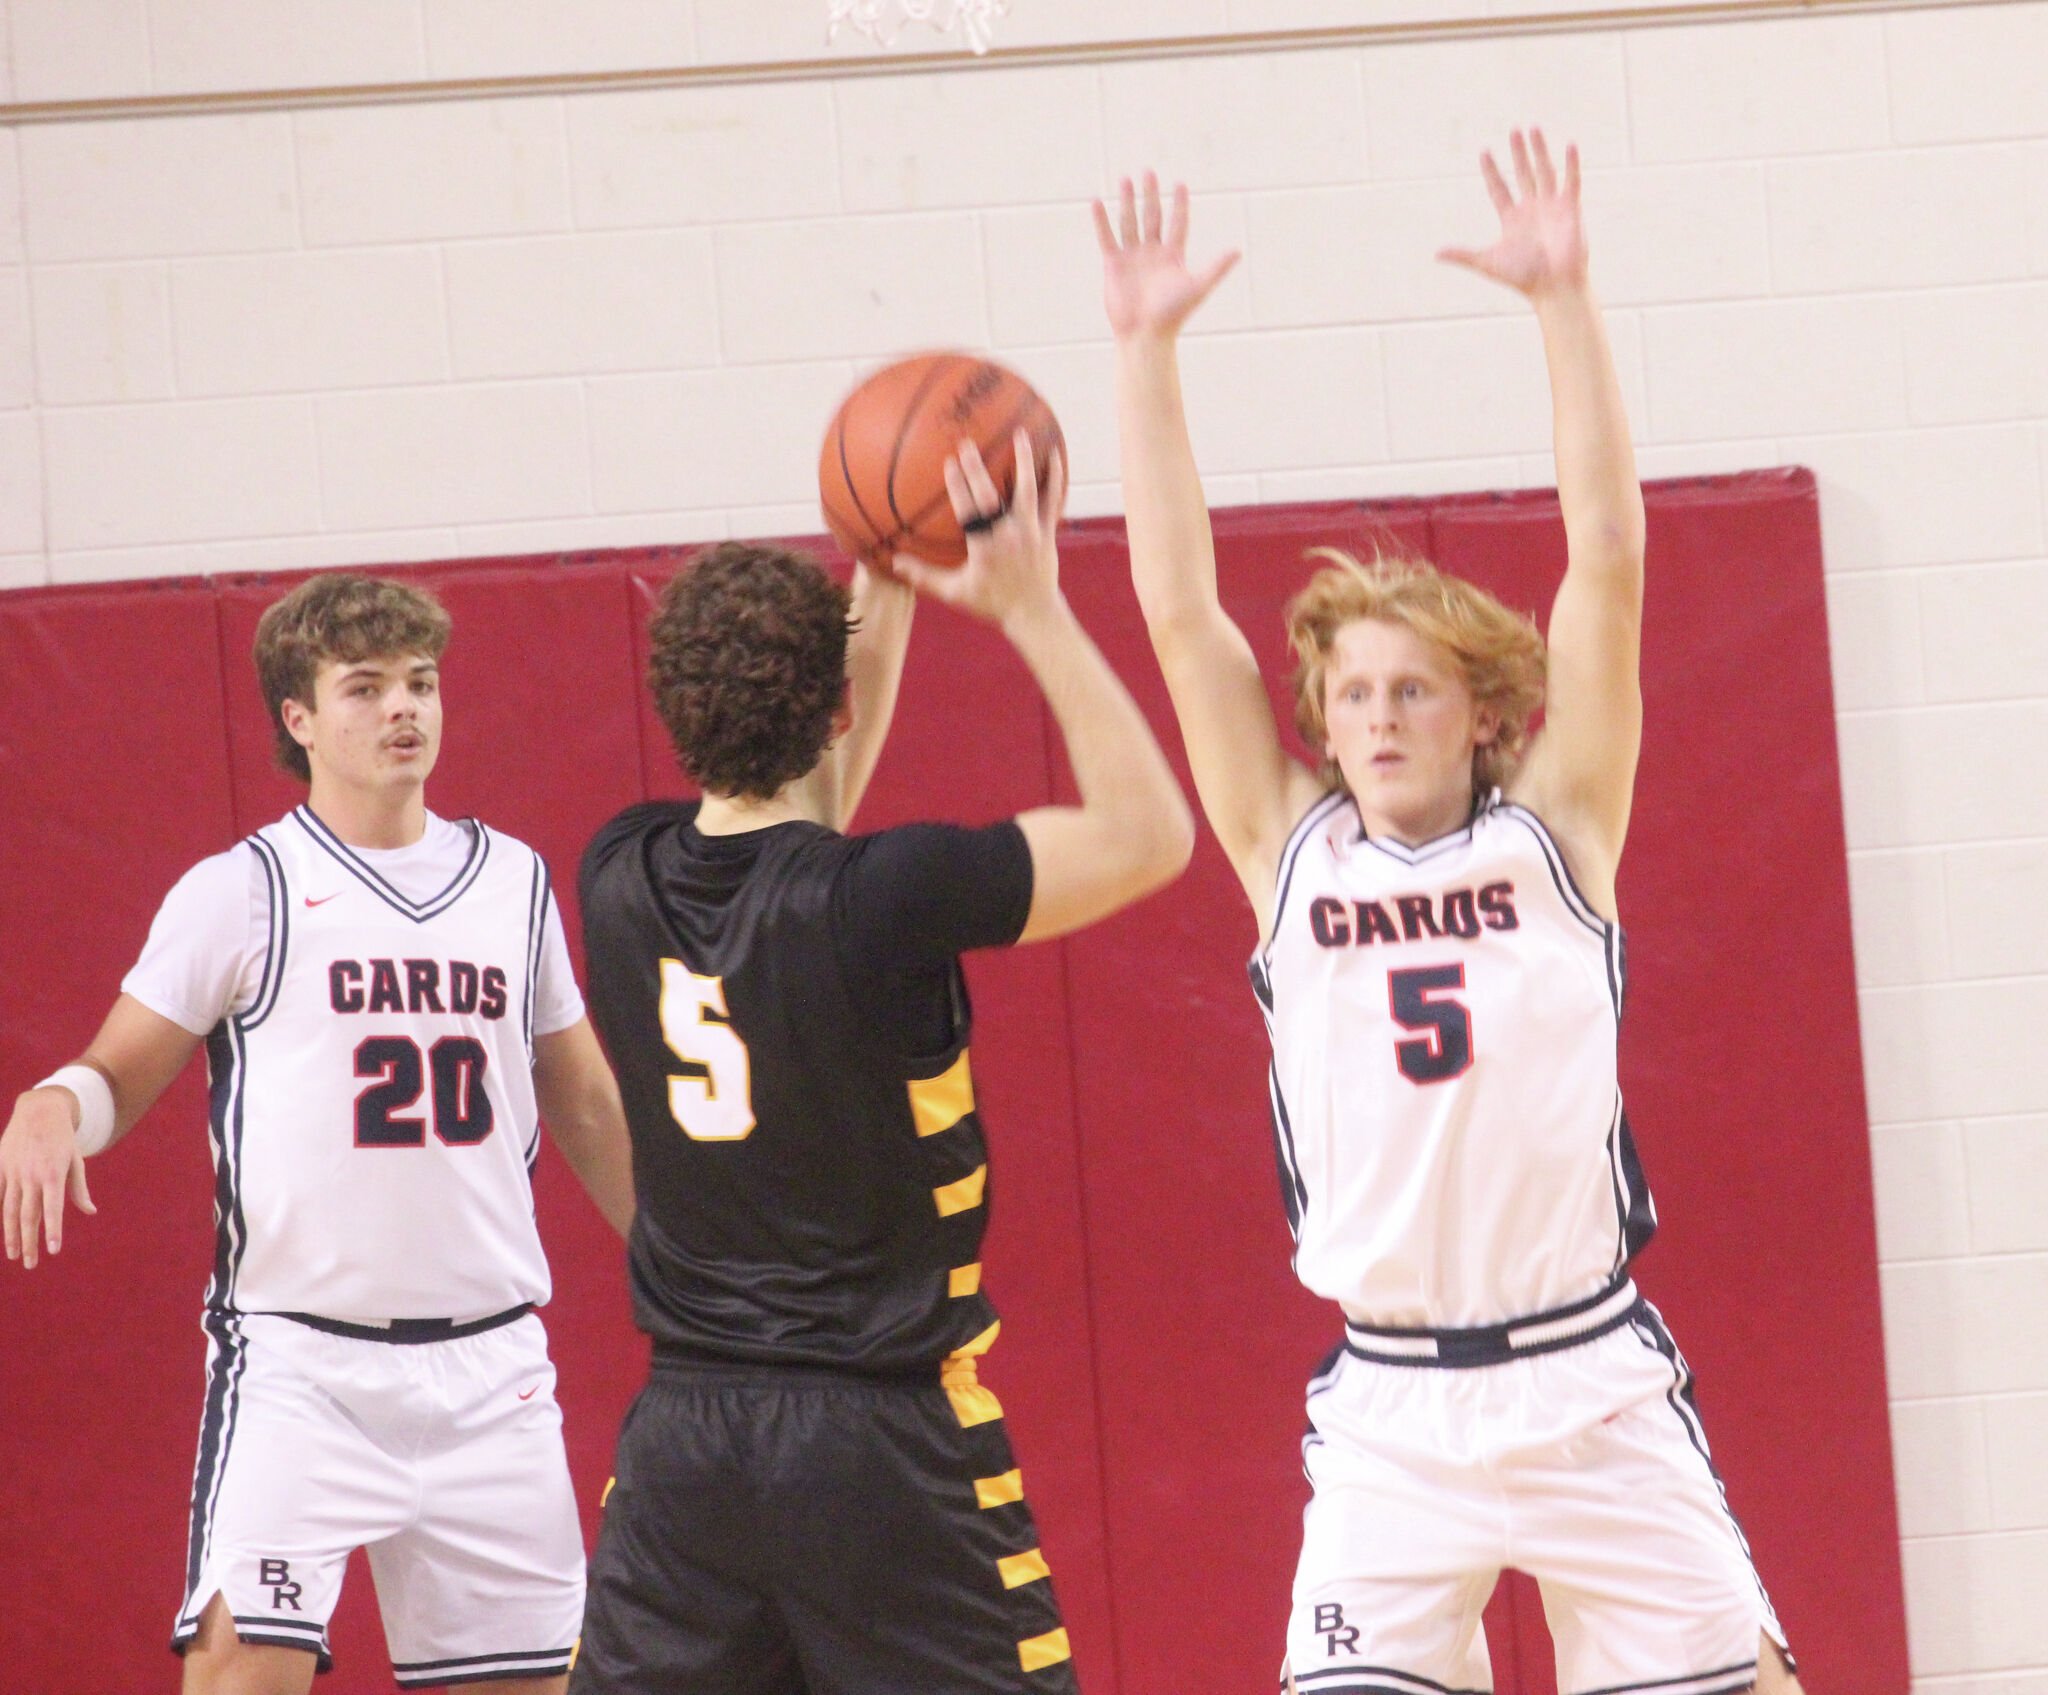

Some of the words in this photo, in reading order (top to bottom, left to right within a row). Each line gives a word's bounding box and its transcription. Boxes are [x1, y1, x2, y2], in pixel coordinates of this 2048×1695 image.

[1309, 880, 1519, 947] CARDS
[329, 958, 507, 1020] CARDS
[1387, 961, 1474, 1086] 5
[353, 1035, 494, 1148] 20
[663, 957, 757, 1141] 5
